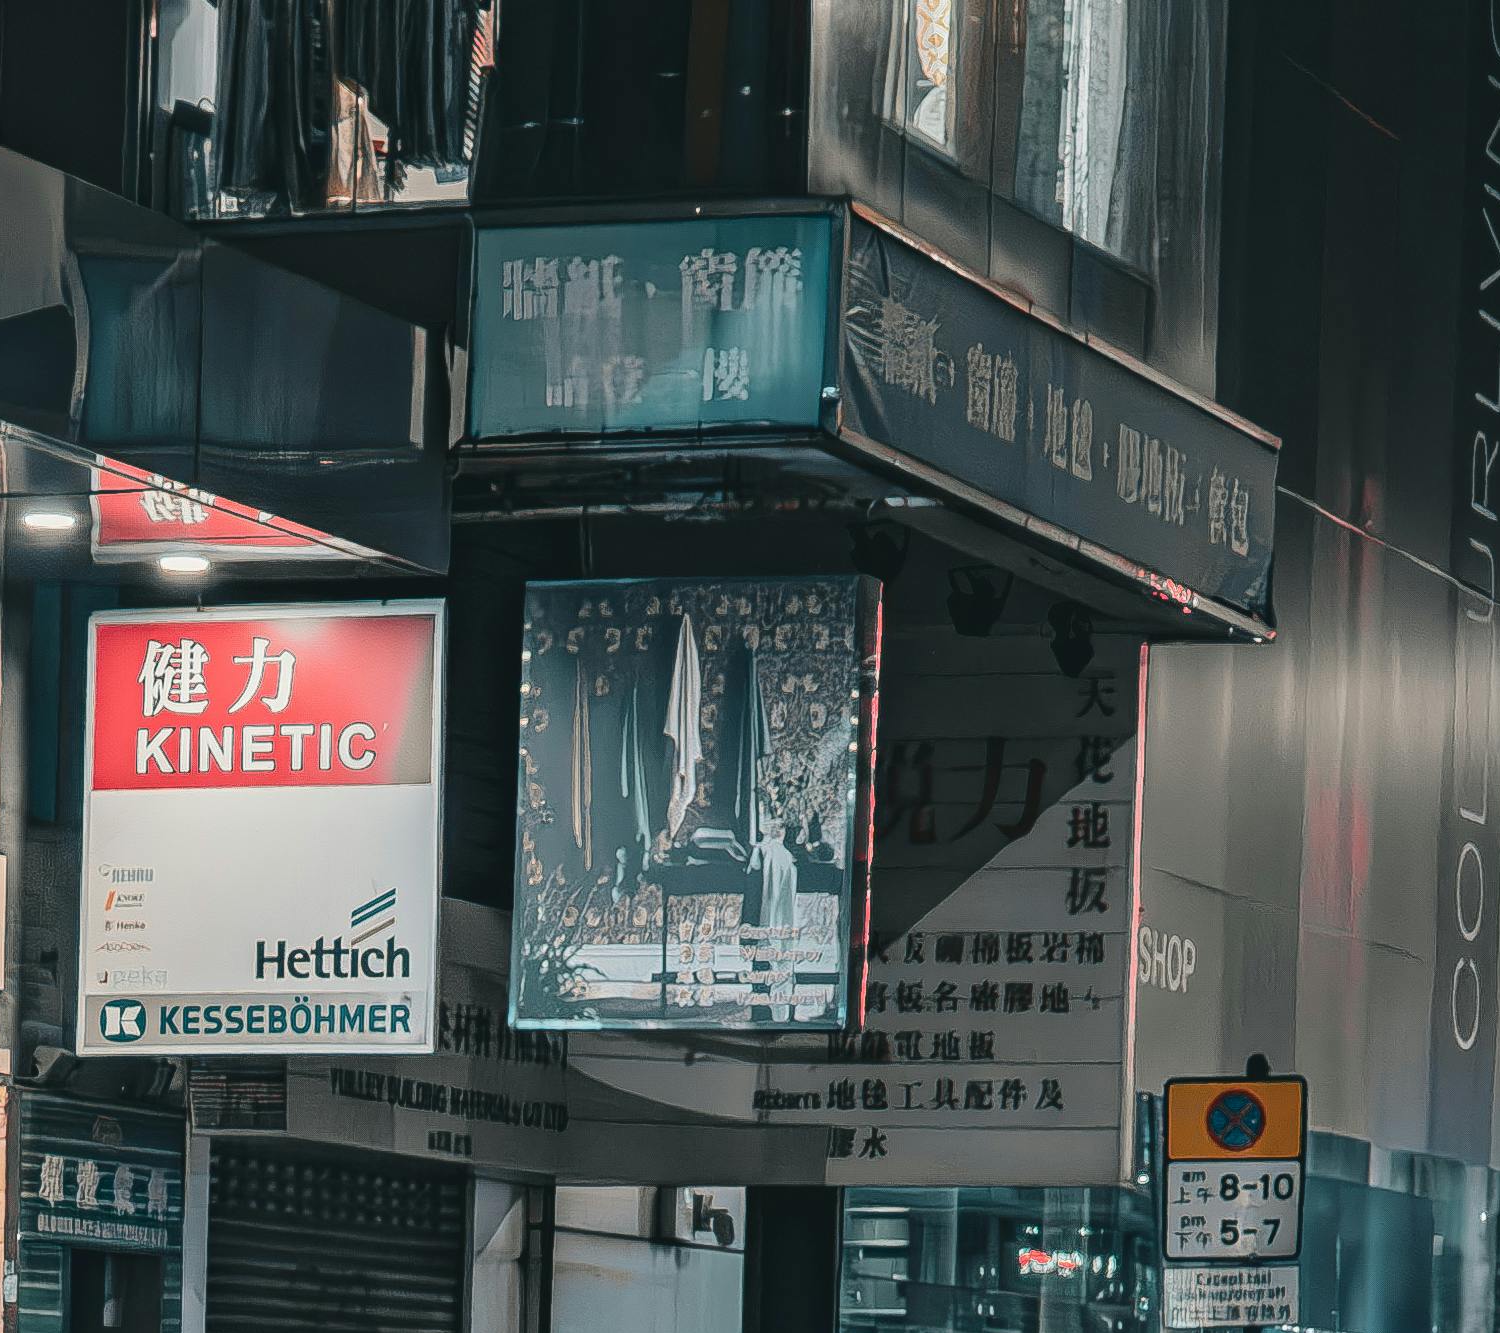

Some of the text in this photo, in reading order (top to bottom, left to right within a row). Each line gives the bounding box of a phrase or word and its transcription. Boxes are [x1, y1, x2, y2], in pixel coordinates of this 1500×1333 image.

[138, 634, 296, 718] 健力
[134, 721, 378, 777] KINETIC
[255, 935, 411, 979] Hettich
[1137, 927, 1198, 993] SHOP
[159, 996, 412, 1035] KESSEBÖHMER
[1173, 1186, 1214, 1204] 上午
[1219, 1172, 1294, 1202] 8-10
[1180, 1215, 1206, 1229] pm
[1220, 1218, 1281, 1246] 5-7
[1174, 1231, 1213, 1249] 下午
